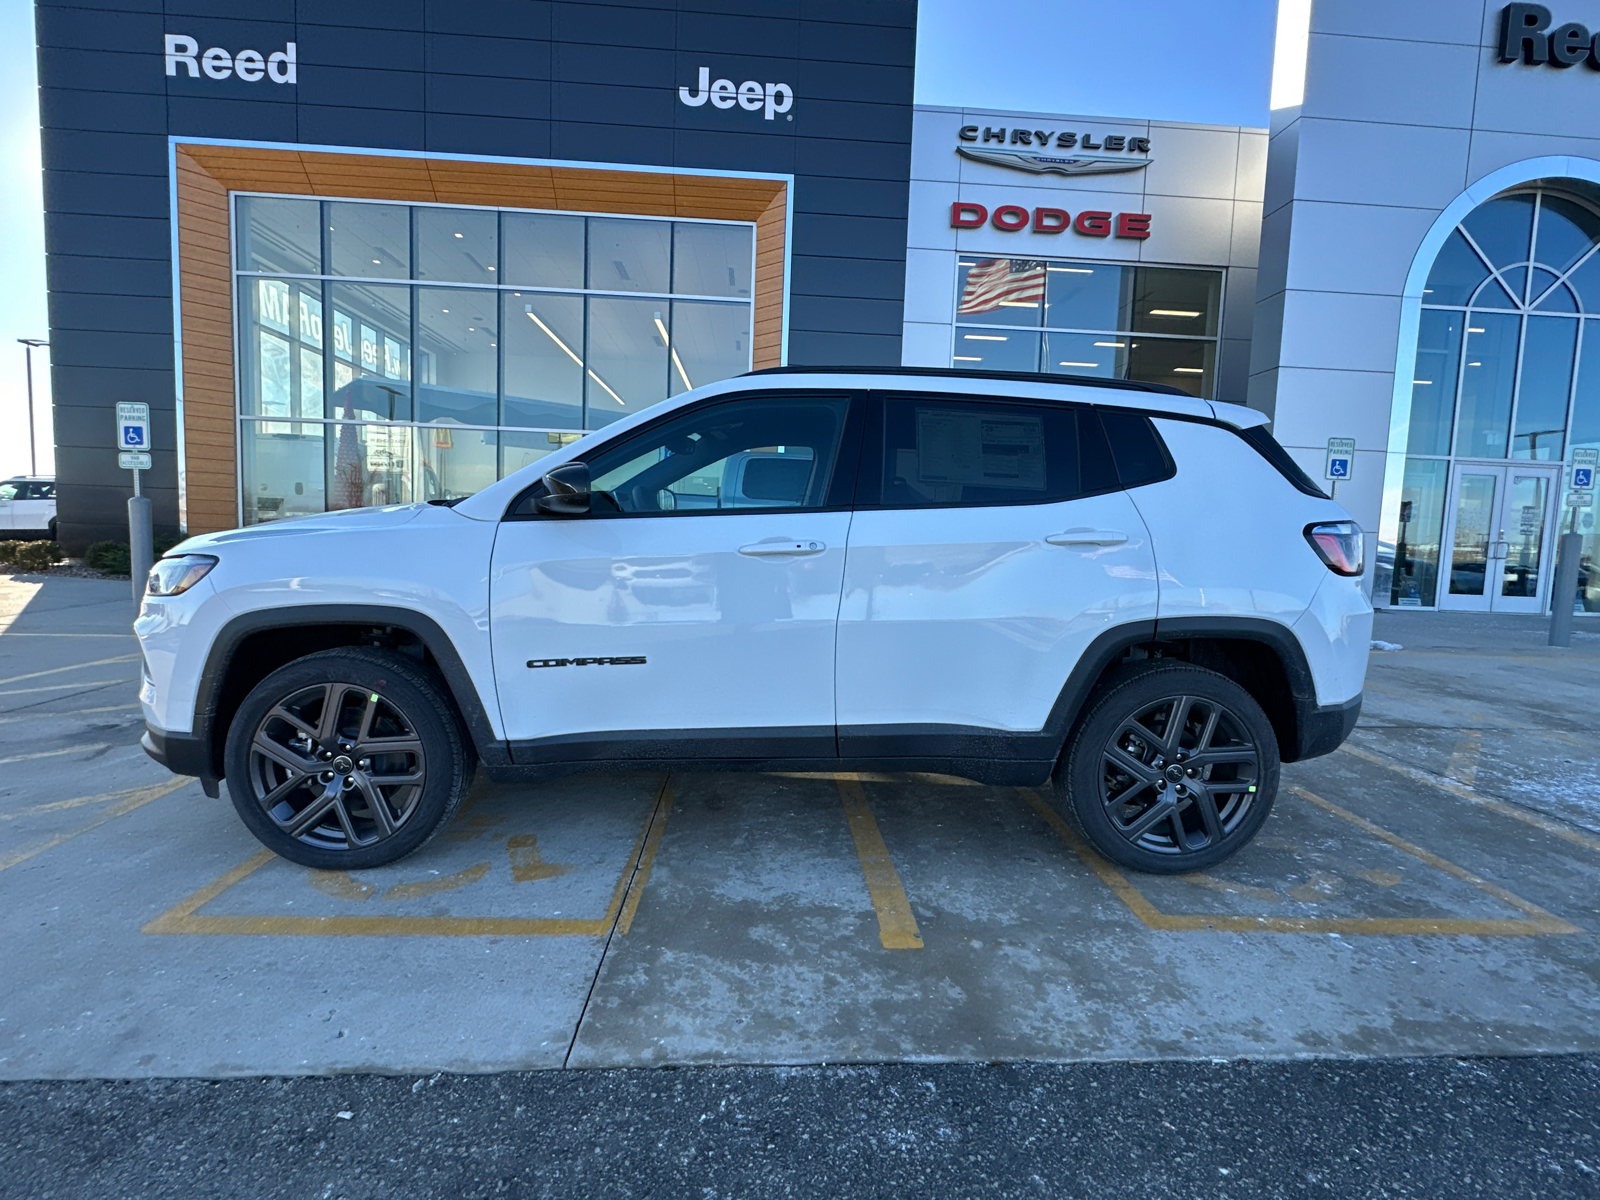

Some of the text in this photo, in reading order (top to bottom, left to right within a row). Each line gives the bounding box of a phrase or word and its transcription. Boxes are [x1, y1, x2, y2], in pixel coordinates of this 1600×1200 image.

[1498, 2, 1600, 72] Re
[164, 33, 297, 84] Reed
[678, 66, 794, 121] Jeep
[958, 125, 1152, 153] CHRYSLER
[950, 201, 1152, 240] DODGE
[120, 406, 146, 414] RESERVED
[526, 656, 647, 668] COMPASS
